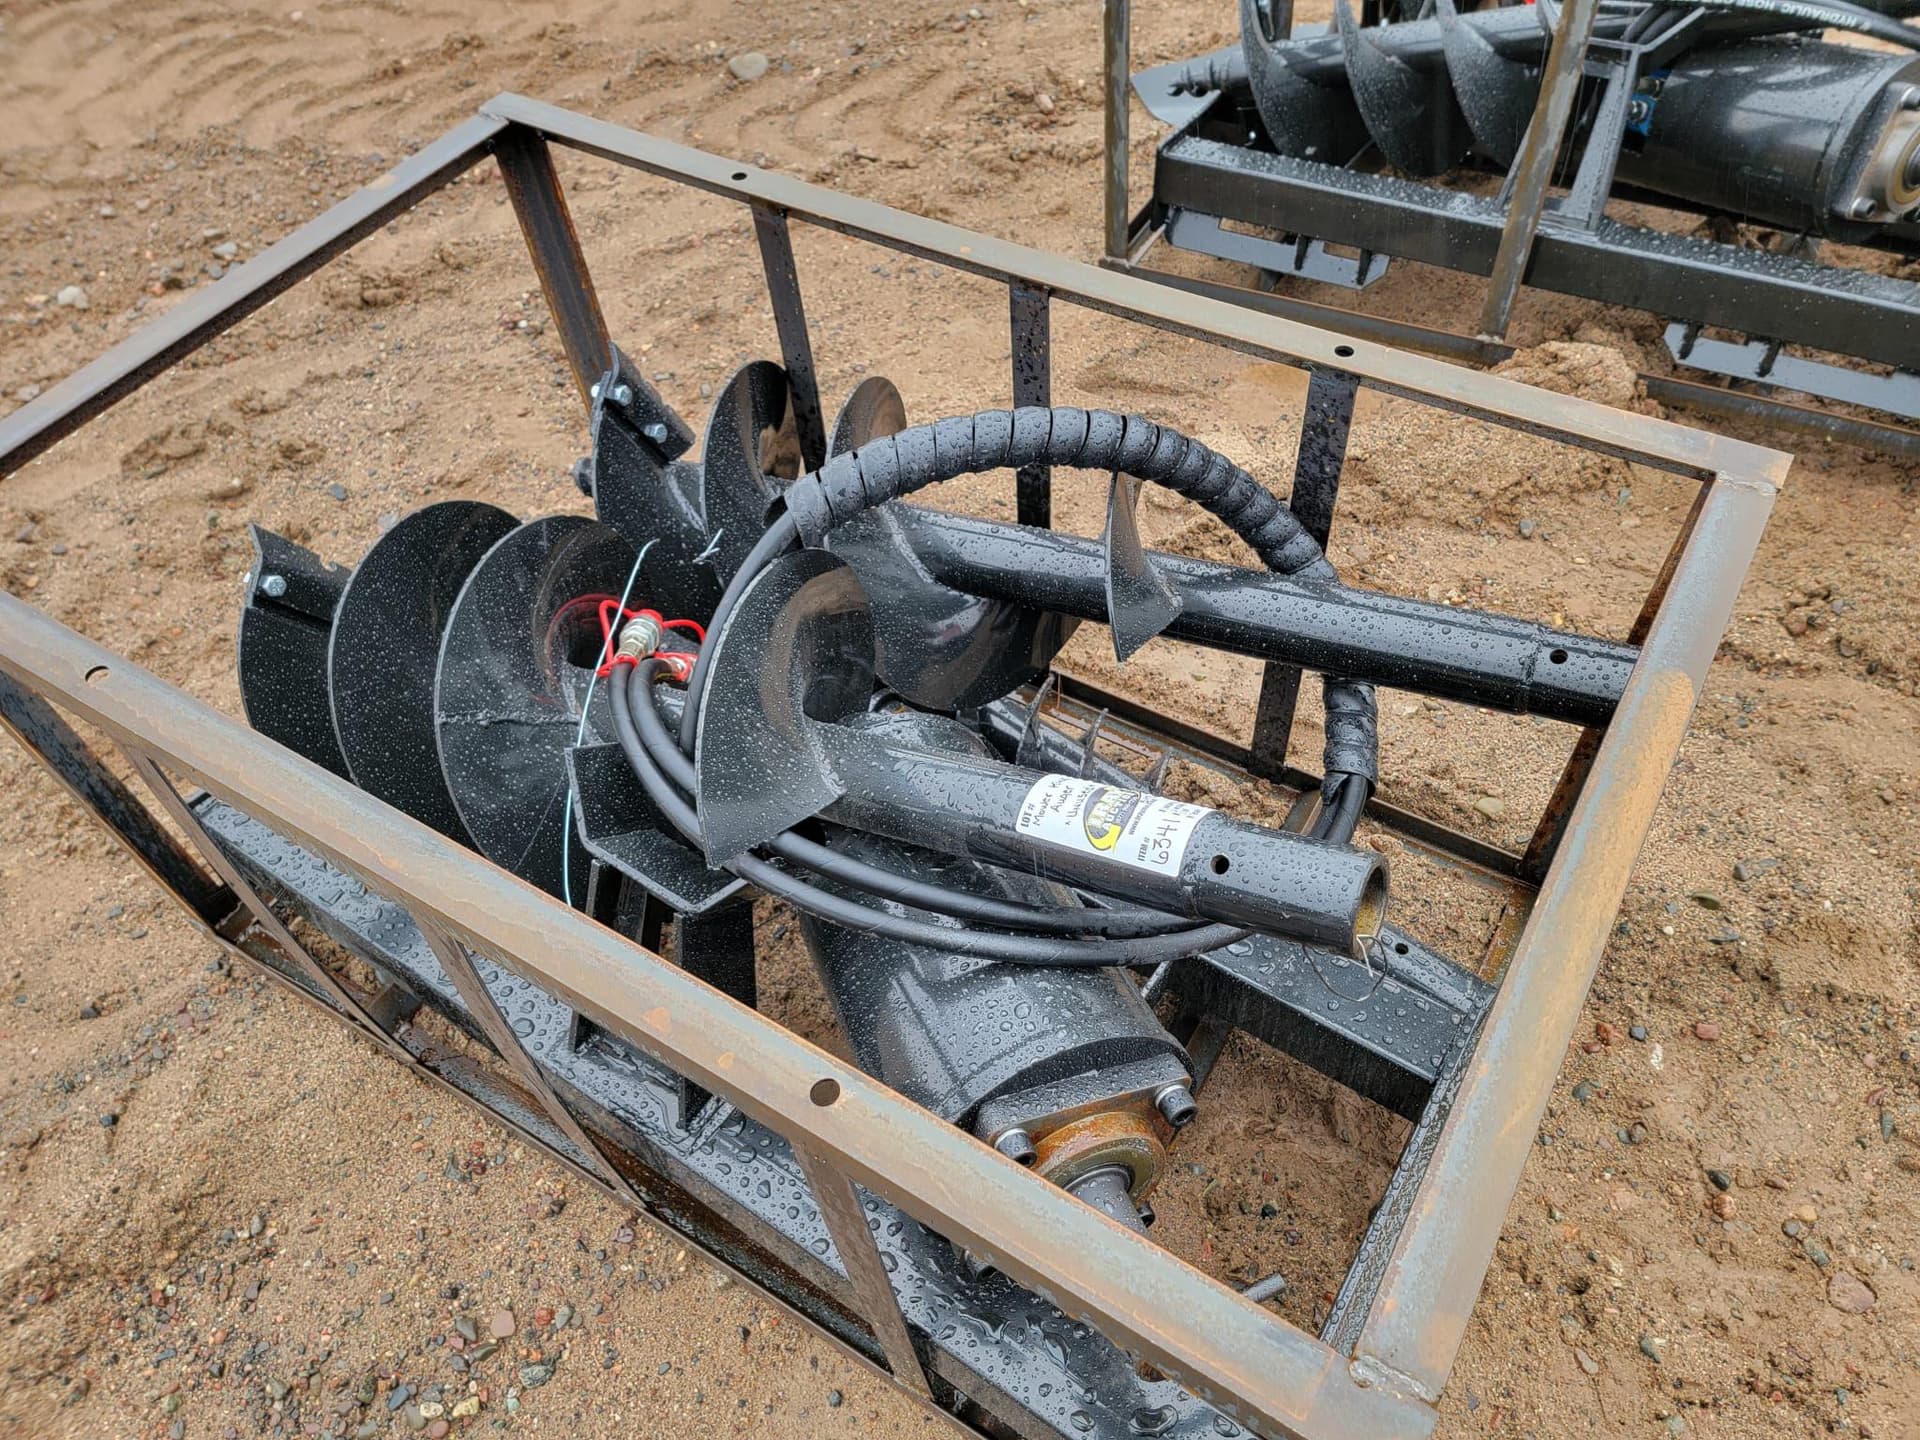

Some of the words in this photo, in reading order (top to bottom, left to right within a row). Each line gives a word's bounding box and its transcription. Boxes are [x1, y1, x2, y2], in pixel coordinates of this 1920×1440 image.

[1780, 5, 1858, 28] HYDRAULIC
[1020, 811, 1033, 828] LOT
[1150, 819, 1182, 865] 6341
